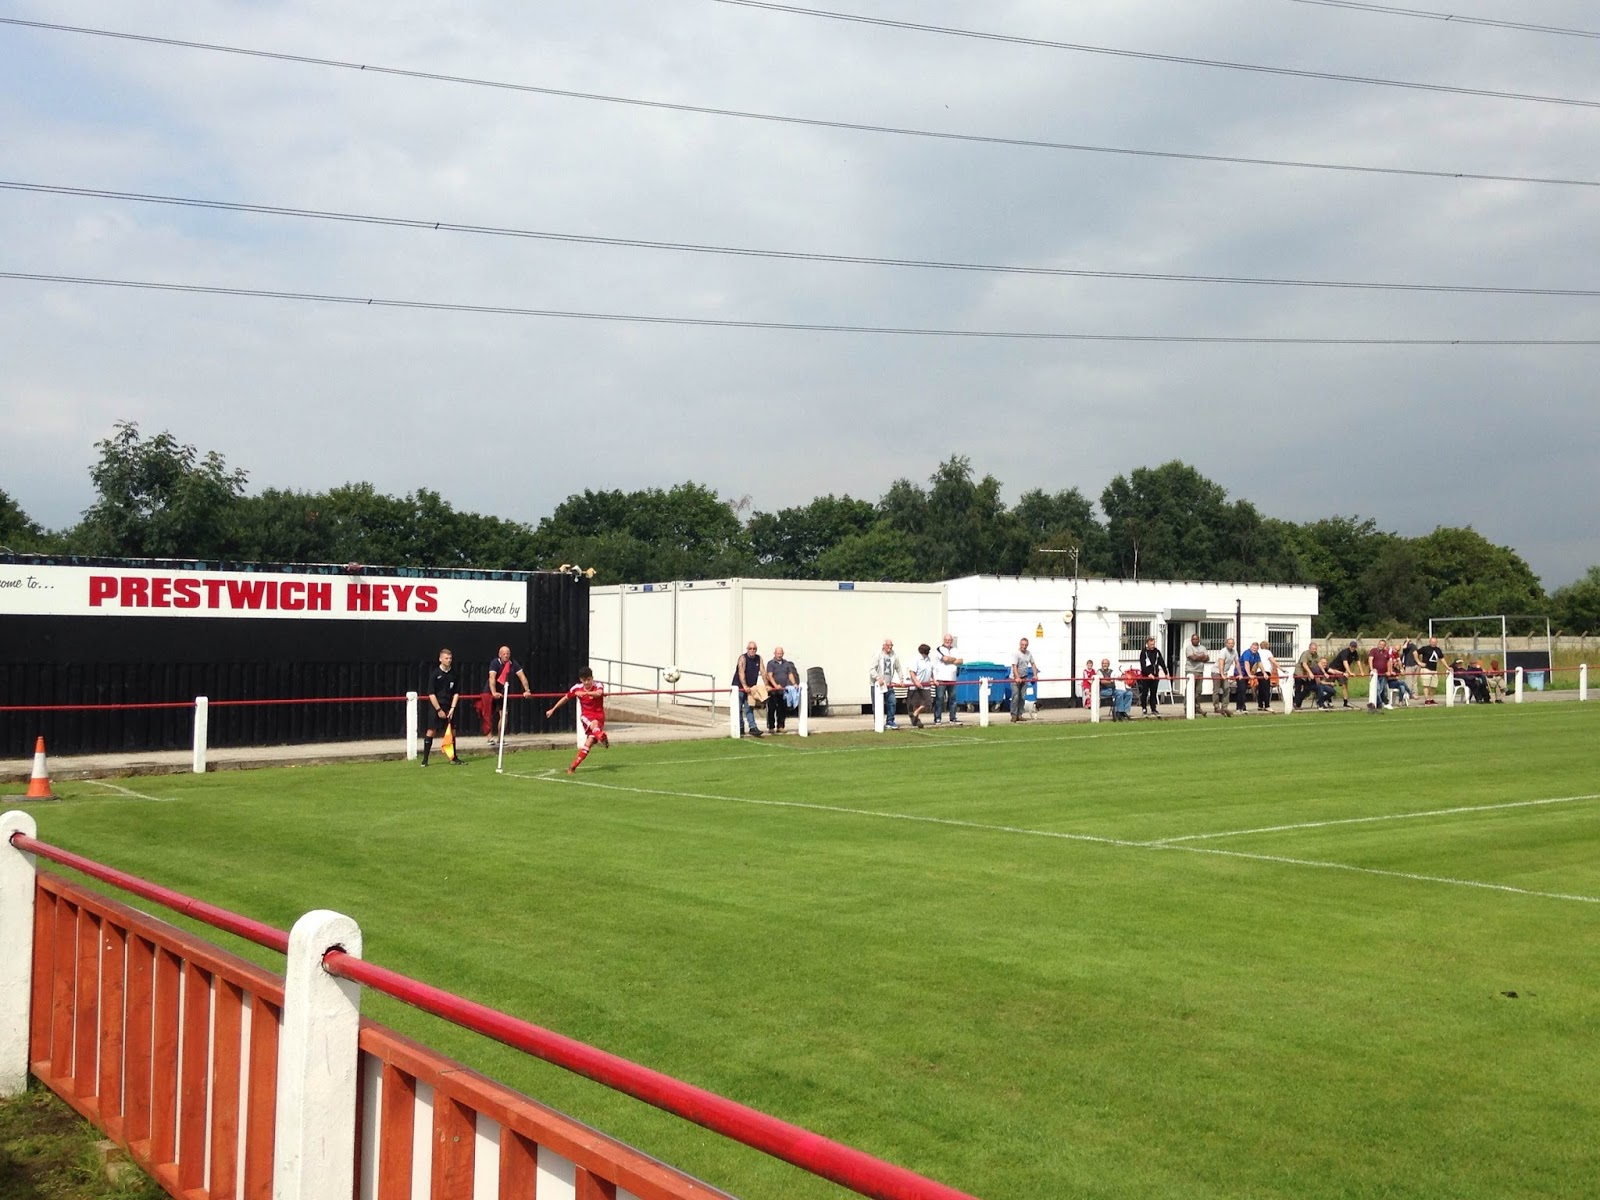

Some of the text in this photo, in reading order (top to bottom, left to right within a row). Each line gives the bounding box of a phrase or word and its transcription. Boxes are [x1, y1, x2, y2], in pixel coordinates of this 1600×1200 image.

[88, 575, 438, 613] PRESTWICH HEYS
[461, 599, 521, 619] Sponsored by
